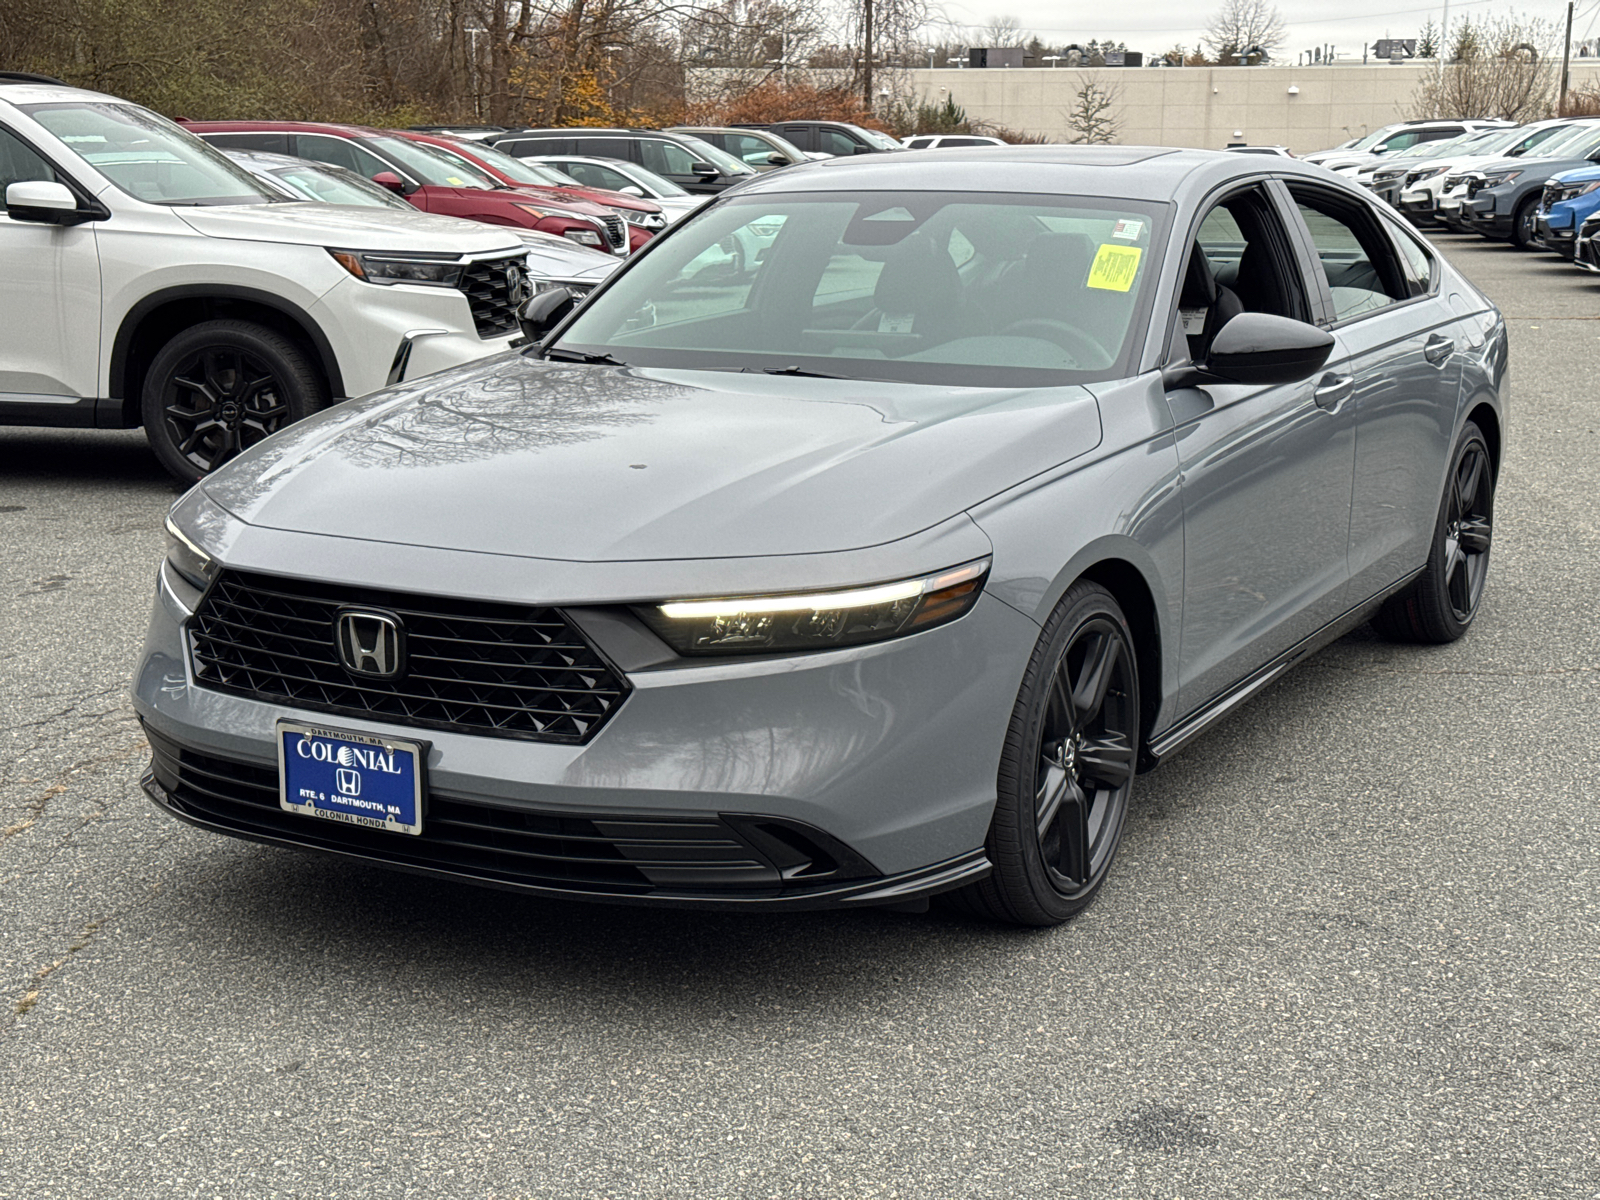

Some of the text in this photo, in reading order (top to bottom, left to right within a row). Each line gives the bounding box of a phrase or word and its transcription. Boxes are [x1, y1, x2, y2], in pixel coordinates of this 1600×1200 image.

[311, 728, 383, 746] DARTMOUTH, MA
[297, 739, 401, 774] COLONIAL
[300, 788, 401, 815] RTE. 6 DARTMOUTH, MA
[314, 808, 387, 829] COLONIAL HONDA
